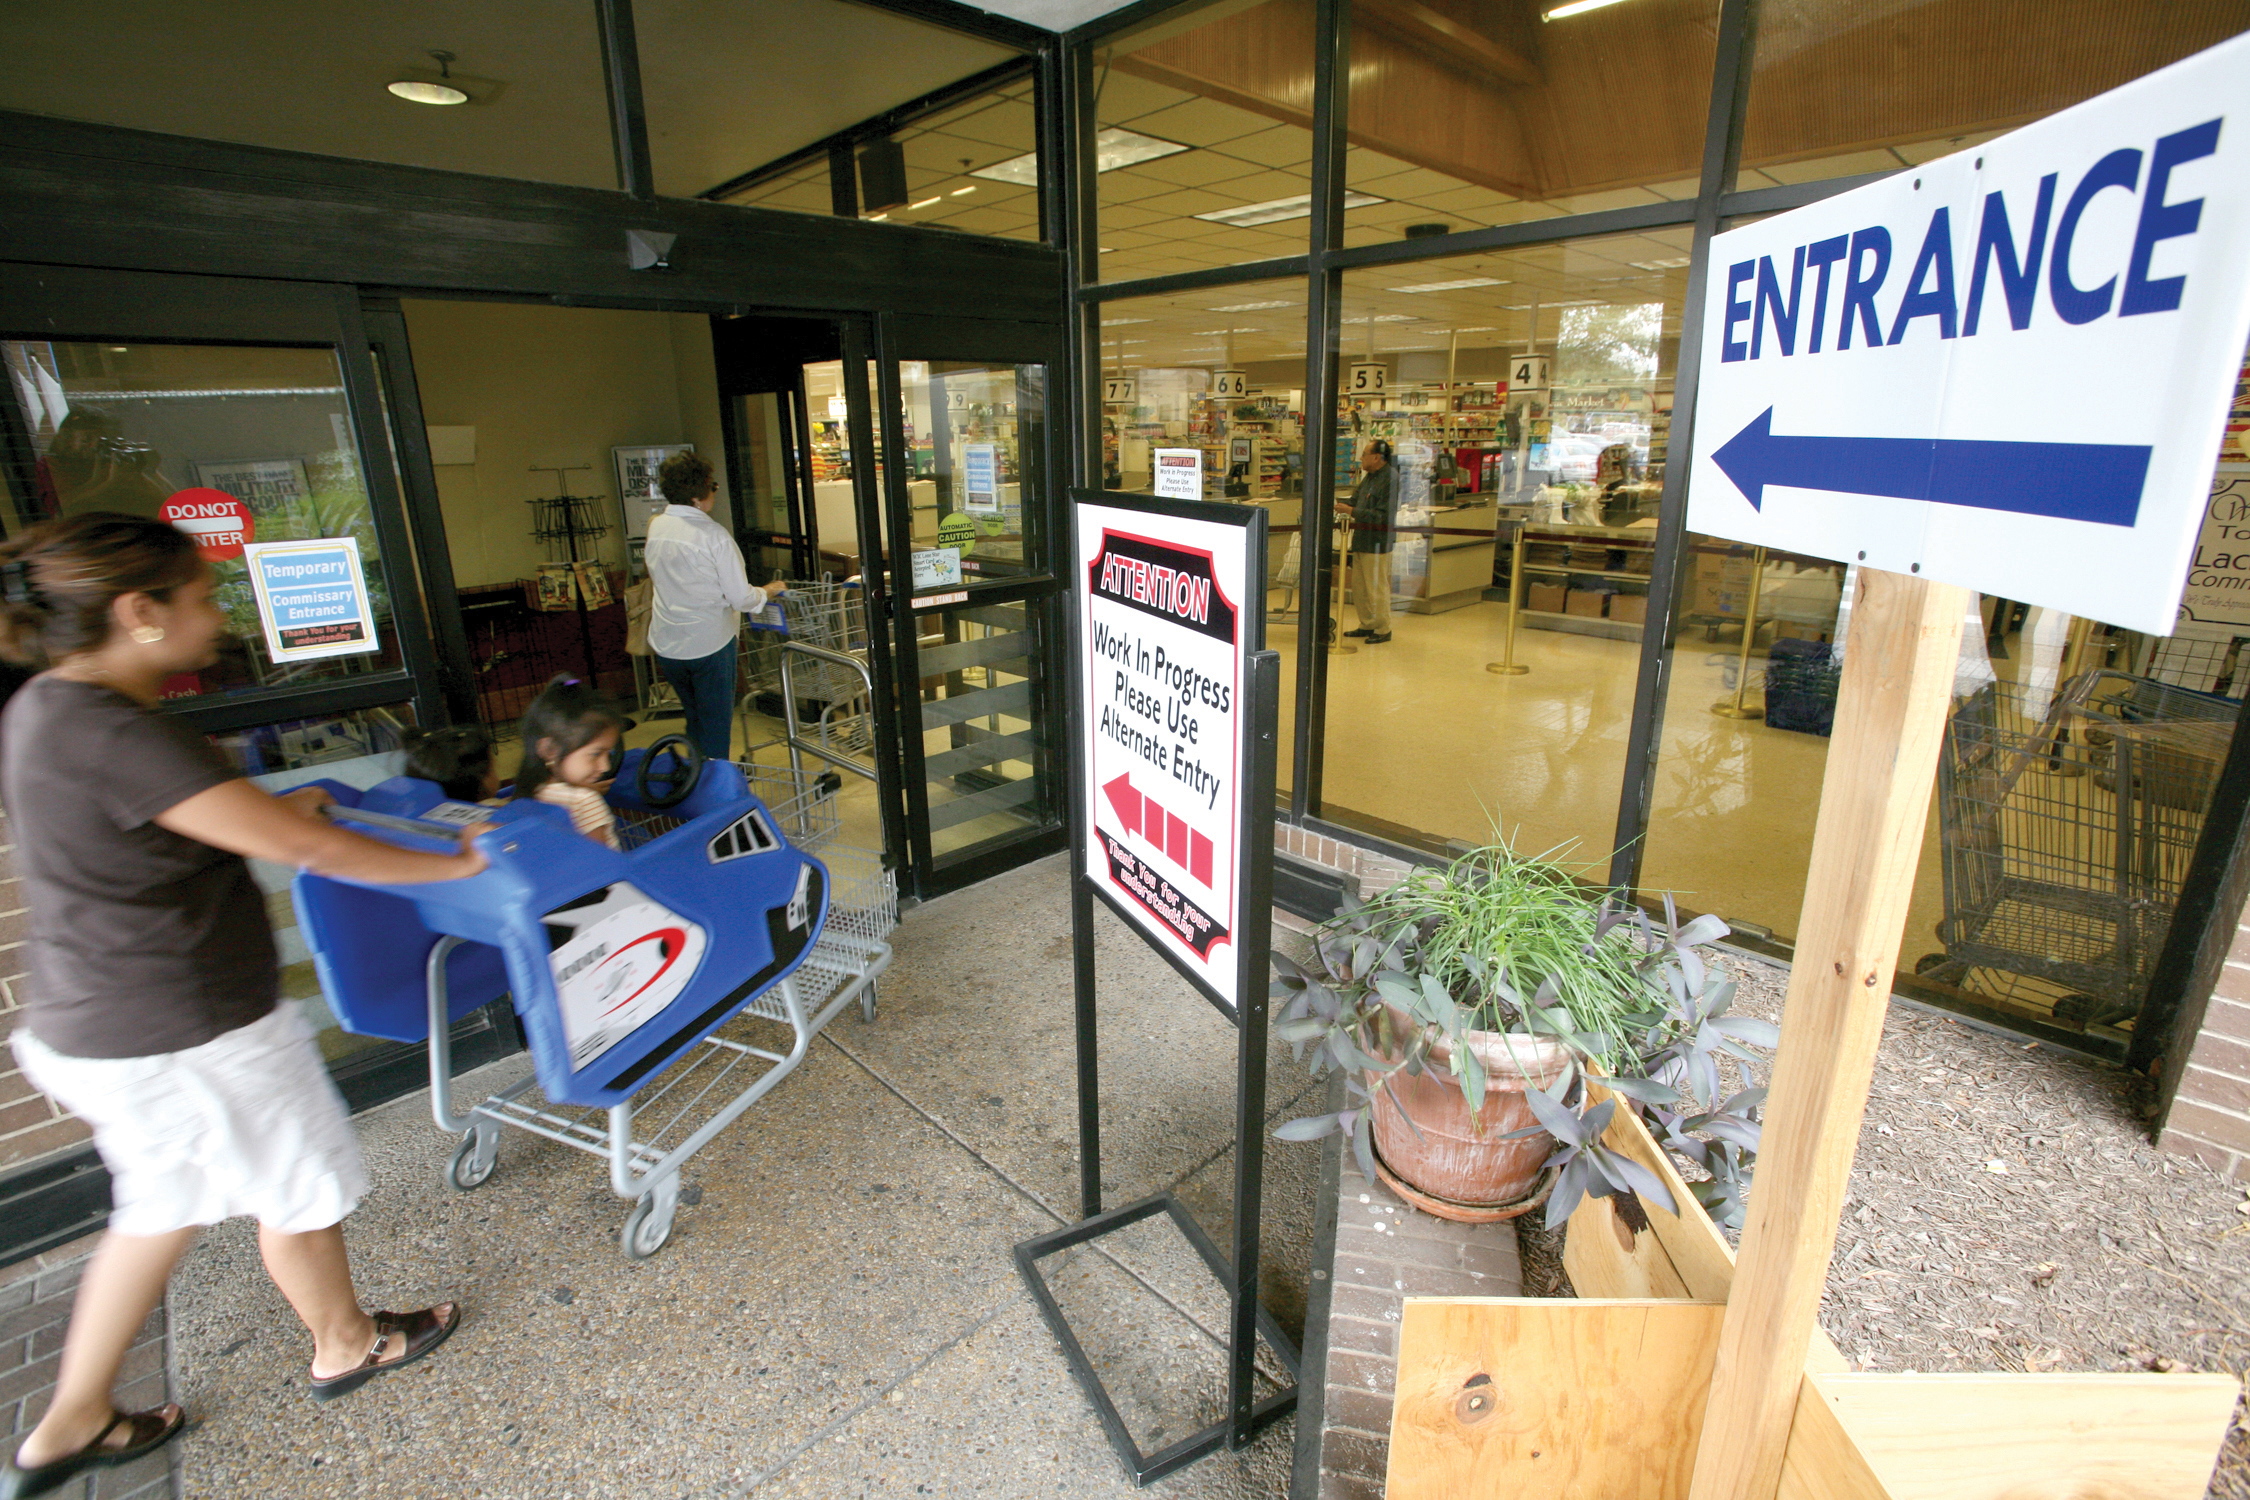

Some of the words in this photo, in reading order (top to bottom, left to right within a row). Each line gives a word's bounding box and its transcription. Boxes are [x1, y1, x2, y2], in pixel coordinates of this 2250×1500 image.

[1720, 115, 2224, 364] ENTRANCE
[1356, 370, 1367, 388] 5
[1376, 370, 1383, 388] 5
[1516, 363, 1531, 384] 4
[1540, 363, 1547, 383] 4
[1109, 383, 1117, 398] 7
[1124, 383, 1131, 398] 7
[1218, 377, 1228, 393] 6
[1235, 377, 1243, 393] 6
[956, 394, 963, 406] 9
[1567, 396, 1605, 407] Market
[1161, 456, 1195, 467] ATTENTION
[211, 473, 234, 482] THE
[167, 504, 198, 519] DO
[198, 502, 238, 517] NOT
[940, 523, 972, 531] AUTOMATIC
[192, 532, 244, 547] NTER
[939, 531, 975, 542] CAUTION
[2194, 545, 2250, 570] Lac
[264, 561, 346, 579] Temporary
[1100, 551, 1210, 625] ATTENTION
[272, 590, 352, 606] Commissary
[912, 597, 934, 608] CAUTION
[936, 594, 952, 604] STAND
[955, 591, 968, 602] BACK
[289, 605, 345, 619] Entrance
[283, 628, 308, 638] Thank
[309, 627, 324, 635] You
[340, 624, 358, 632] your
[294, 633, 351, 645] understanding
[1093, 619, 1131, 667] Work
[1136, 638, 1150, 676] In
[1154, 645, 1230, 713] Progress
[1115, 670, 1161, 724] Please
[1168, 696, 1198, 745] Use
[1100, 704, 1167, 771] Alternate
[1173, 743, 1221, 811] Entry
[1108, 838, 1136, 871] Thank
[1138, 861, 1156, 889] You
[1161, 882, 1179, 904] for
[1183, 902, 1211, 933] your
[1120, 867, 1195, 943] understanding
